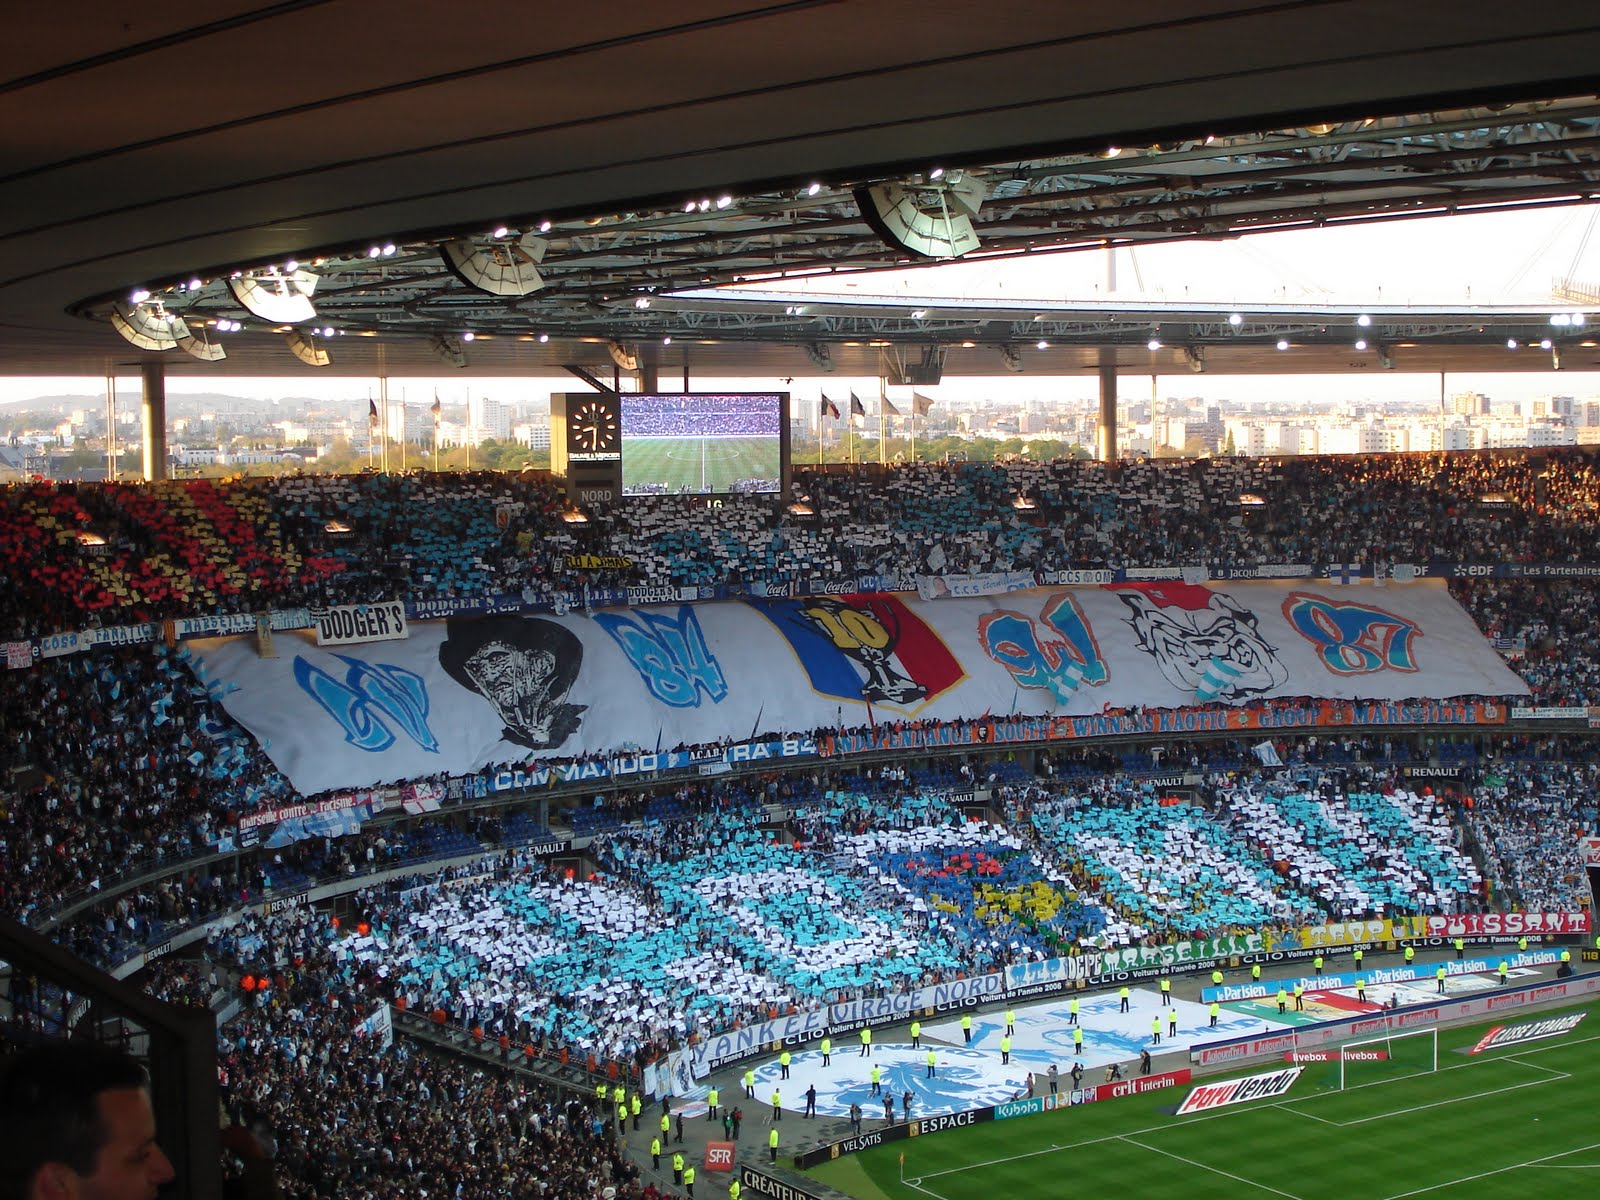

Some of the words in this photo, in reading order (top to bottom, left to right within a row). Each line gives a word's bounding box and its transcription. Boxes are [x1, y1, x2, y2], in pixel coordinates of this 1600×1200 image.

[581, 490, 612, 501] NORD
[1059, 571, 1081, 583] CCS
[1412, 566, 1429, 576] DF
[1523, 566, 1541, 575] Les
[321, 604, 403, 640] DODGER'S
[1159, 710, 1228, 732] KAOTIC
[1258, 707, 1321, 728] GROUP
[1352, 705, 1477, 725] MARSEILLE
[782, 739, 817, 757] 84
[1412, 768, 1460, 777] RENAULT
[529, 842, 566, 856] ENAULT
[1104, 932, 1266, 974] MARSEILLE
[1310, 920, 1385, 944] TROP
[1428, 913, 1586, 937] PUISSANT
[1400, 937, 1443, 947] CLIO
[1490, 935, 1519, 943] l'année
[1243, 951, 1284, 964] CLIO
[1287, 949, 1314, 959] Voiture
[1315, 947, 1325, 956] de
[1326, 945, 1351, 955] l'année
[1518, 950, 1556, 966] Parisien
[1088, 972, 1130, 985] CLIO
[1133, 968, 1159, 979] Voiture
[1160, 967, 1169, 976] de
[1171, 963, 1196, 974] l'année
[1197, 961, 1215, 970] 2006
[1447, 960, 1487, 974] Parisien
[1301, 976, 1341, 991] Parisien
[1375, 968, 1415, 983] Parisien
[936, 996, 978, 1012] CLIO
[980, 991, 1007, 1003] Voiture
[1007, 988, 1017, 999] de
[1017, 985, 1044, 997] l'année
[1044, 982, 1062, 992] 2006
[1216, 990, 1225, 1001] le
[1224, 984, 1266, 1001] Parisien
[693, 1011, 820, 1064] YANKEE
[833, 991, 923, 1022] VIRAGE
[934, 975, 999, 1005] NORD
[785, 1028, 824, 1045] CLIO
[828, 1020, 855, 1035] Voiture
[855, 1018, 865, 1029] de
[866, 1014, 892, 1027] l'année
[893, 1011, 910, 1021] 2006
[711, 1056, 719, 1068] de
[719, 1050, 743, 1064] l'année
[743, 1047, 760, 1058] 2006
[1292, 1052, 1327, 1061] livebox
[1344, 1051, 1378, 1060] livebox
[1112, 1080, 1138, 1098] crit
[998, 1101, 1038, 1117] Kubota
[921, 1111, 975, 1134] ESPACE
[709, 1148, 731, 1164] SFR
